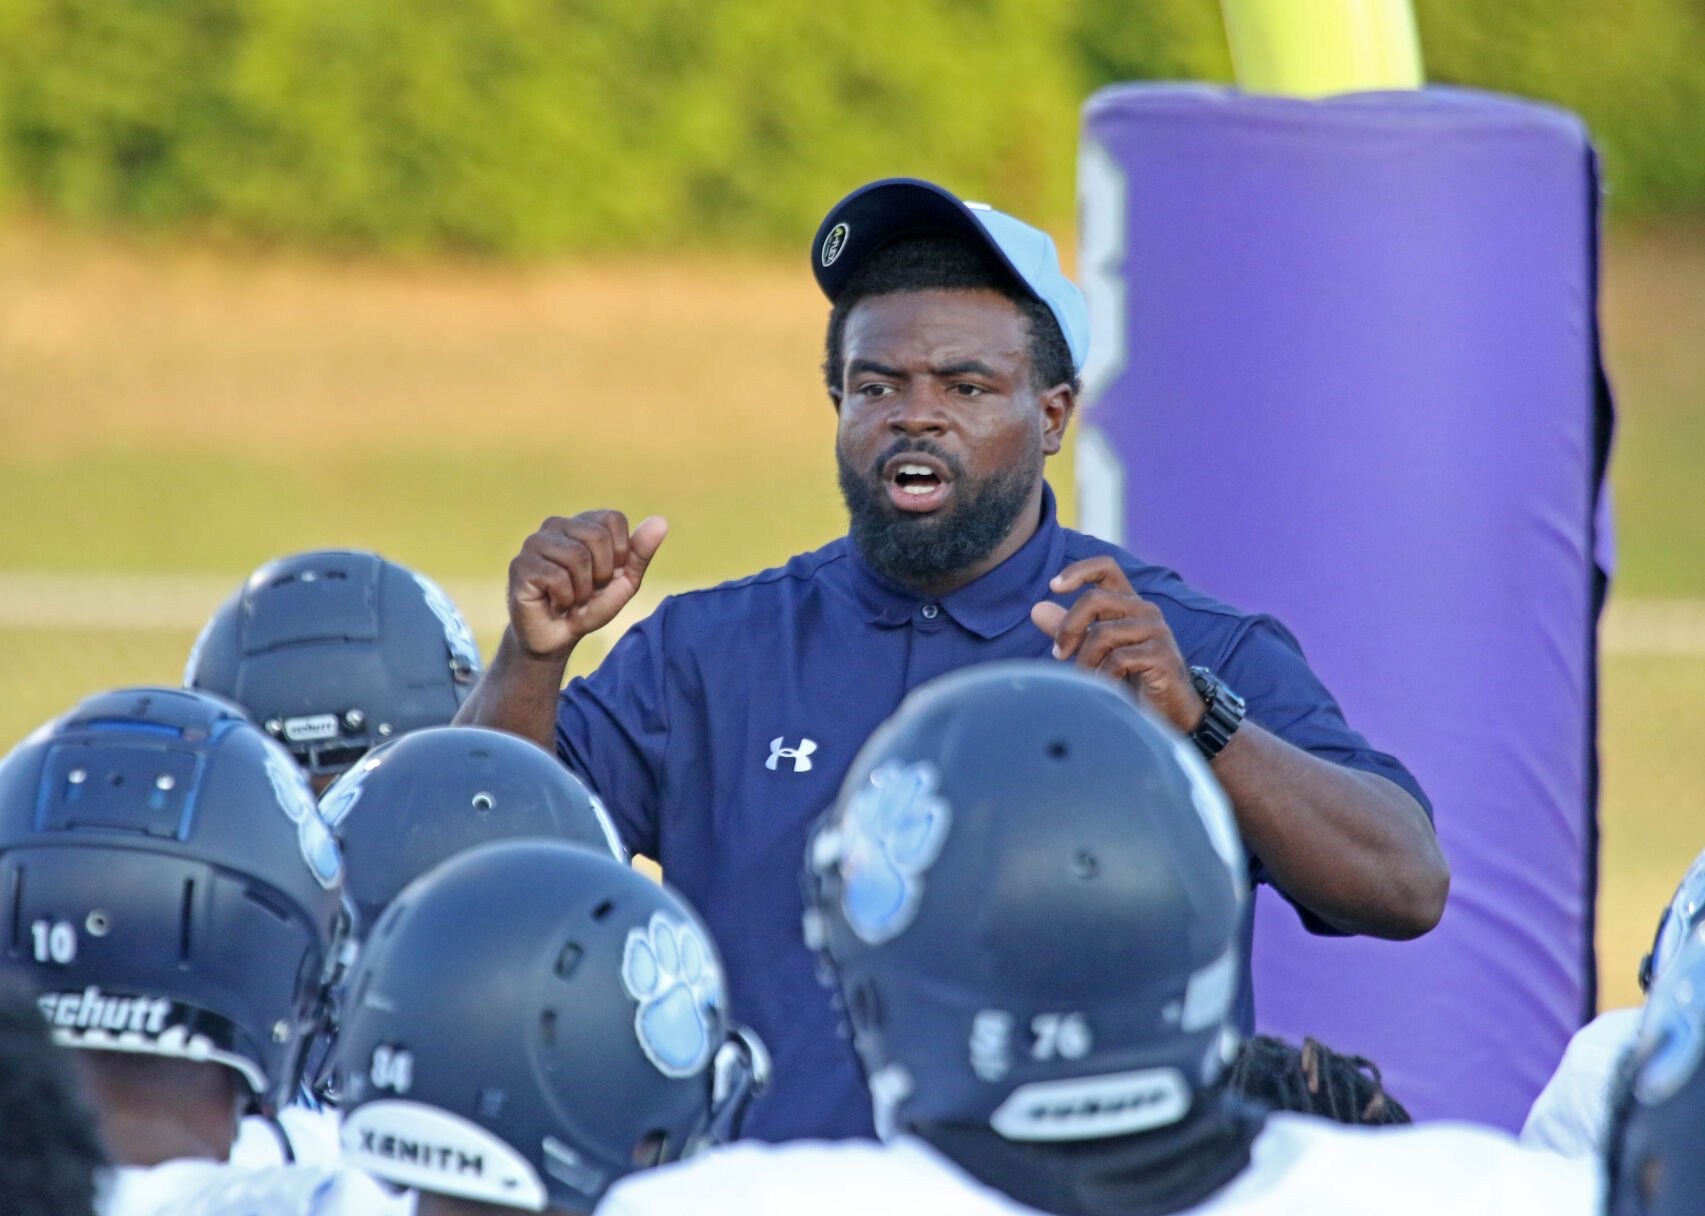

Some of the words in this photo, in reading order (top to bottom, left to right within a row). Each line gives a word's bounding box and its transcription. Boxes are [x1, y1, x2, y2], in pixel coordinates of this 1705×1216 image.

[32, 920, 77, 963] 10
[38, 985, 172, 1032] schutt
[361, 1130, 484, 1175] XENITH
